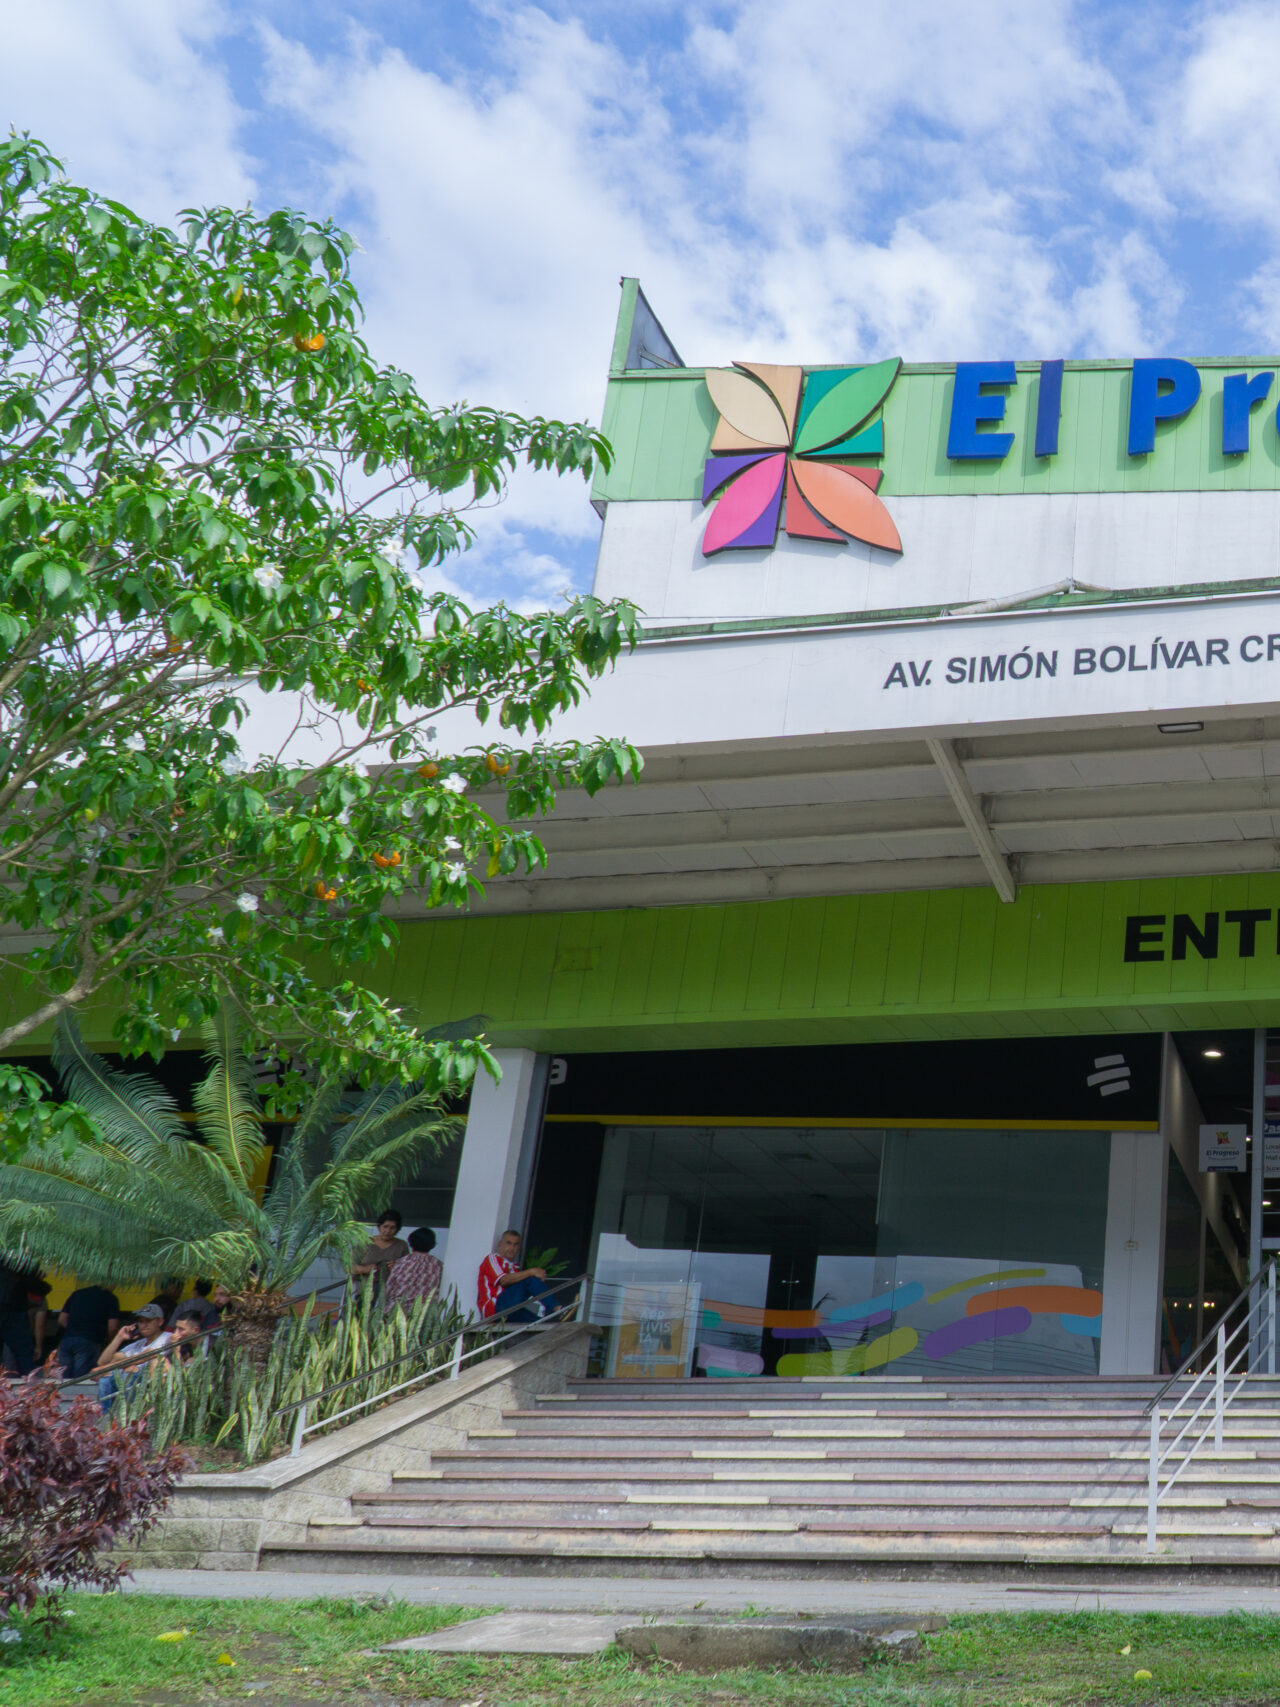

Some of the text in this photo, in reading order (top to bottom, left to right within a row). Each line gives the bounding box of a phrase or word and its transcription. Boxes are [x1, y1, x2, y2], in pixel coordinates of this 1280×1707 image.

[946, 359, 1063, 461] El
[883, 660, 932, 690] AV.
[945, 645, 1059, 684] SIMÓN
[1073, 635, 1231, 676] BOLÍVAR
